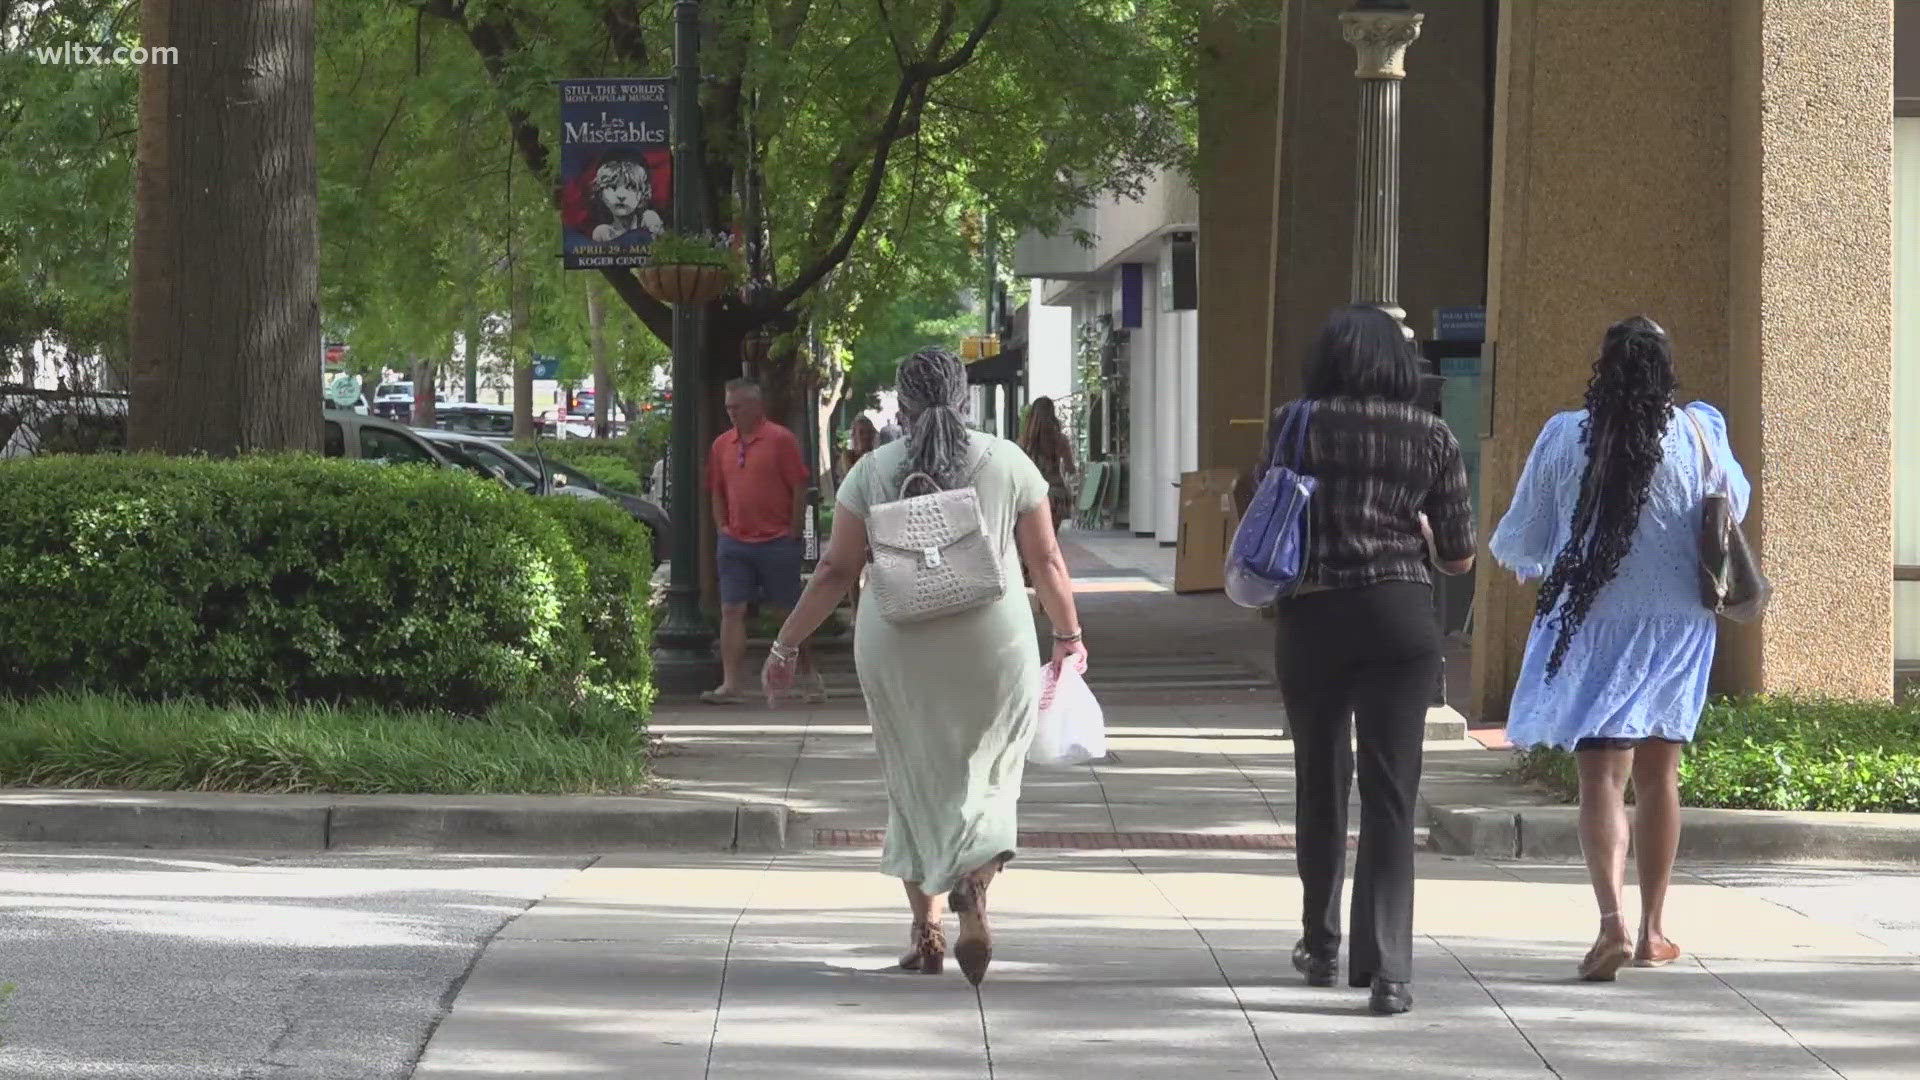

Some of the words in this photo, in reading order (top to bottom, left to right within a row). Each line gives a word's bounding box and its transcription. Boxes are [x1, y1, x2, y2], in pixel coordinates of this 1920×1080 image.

[564, 85, 592, 95] STILL
[596, 85, 617, 95] THE
[620, 84, 665, 95] WORLD'S
[565, 95, 588, 103] MOST
[629, 94, 664, 102] MUSICAL
[601, 111, 625, 128] Les
[564, 121, 665, 144] Misérables
[572, 245, 606, 255] APRIL
[609, 245, 620, 254] 29
[578, 256, 614, 266] KOGER
